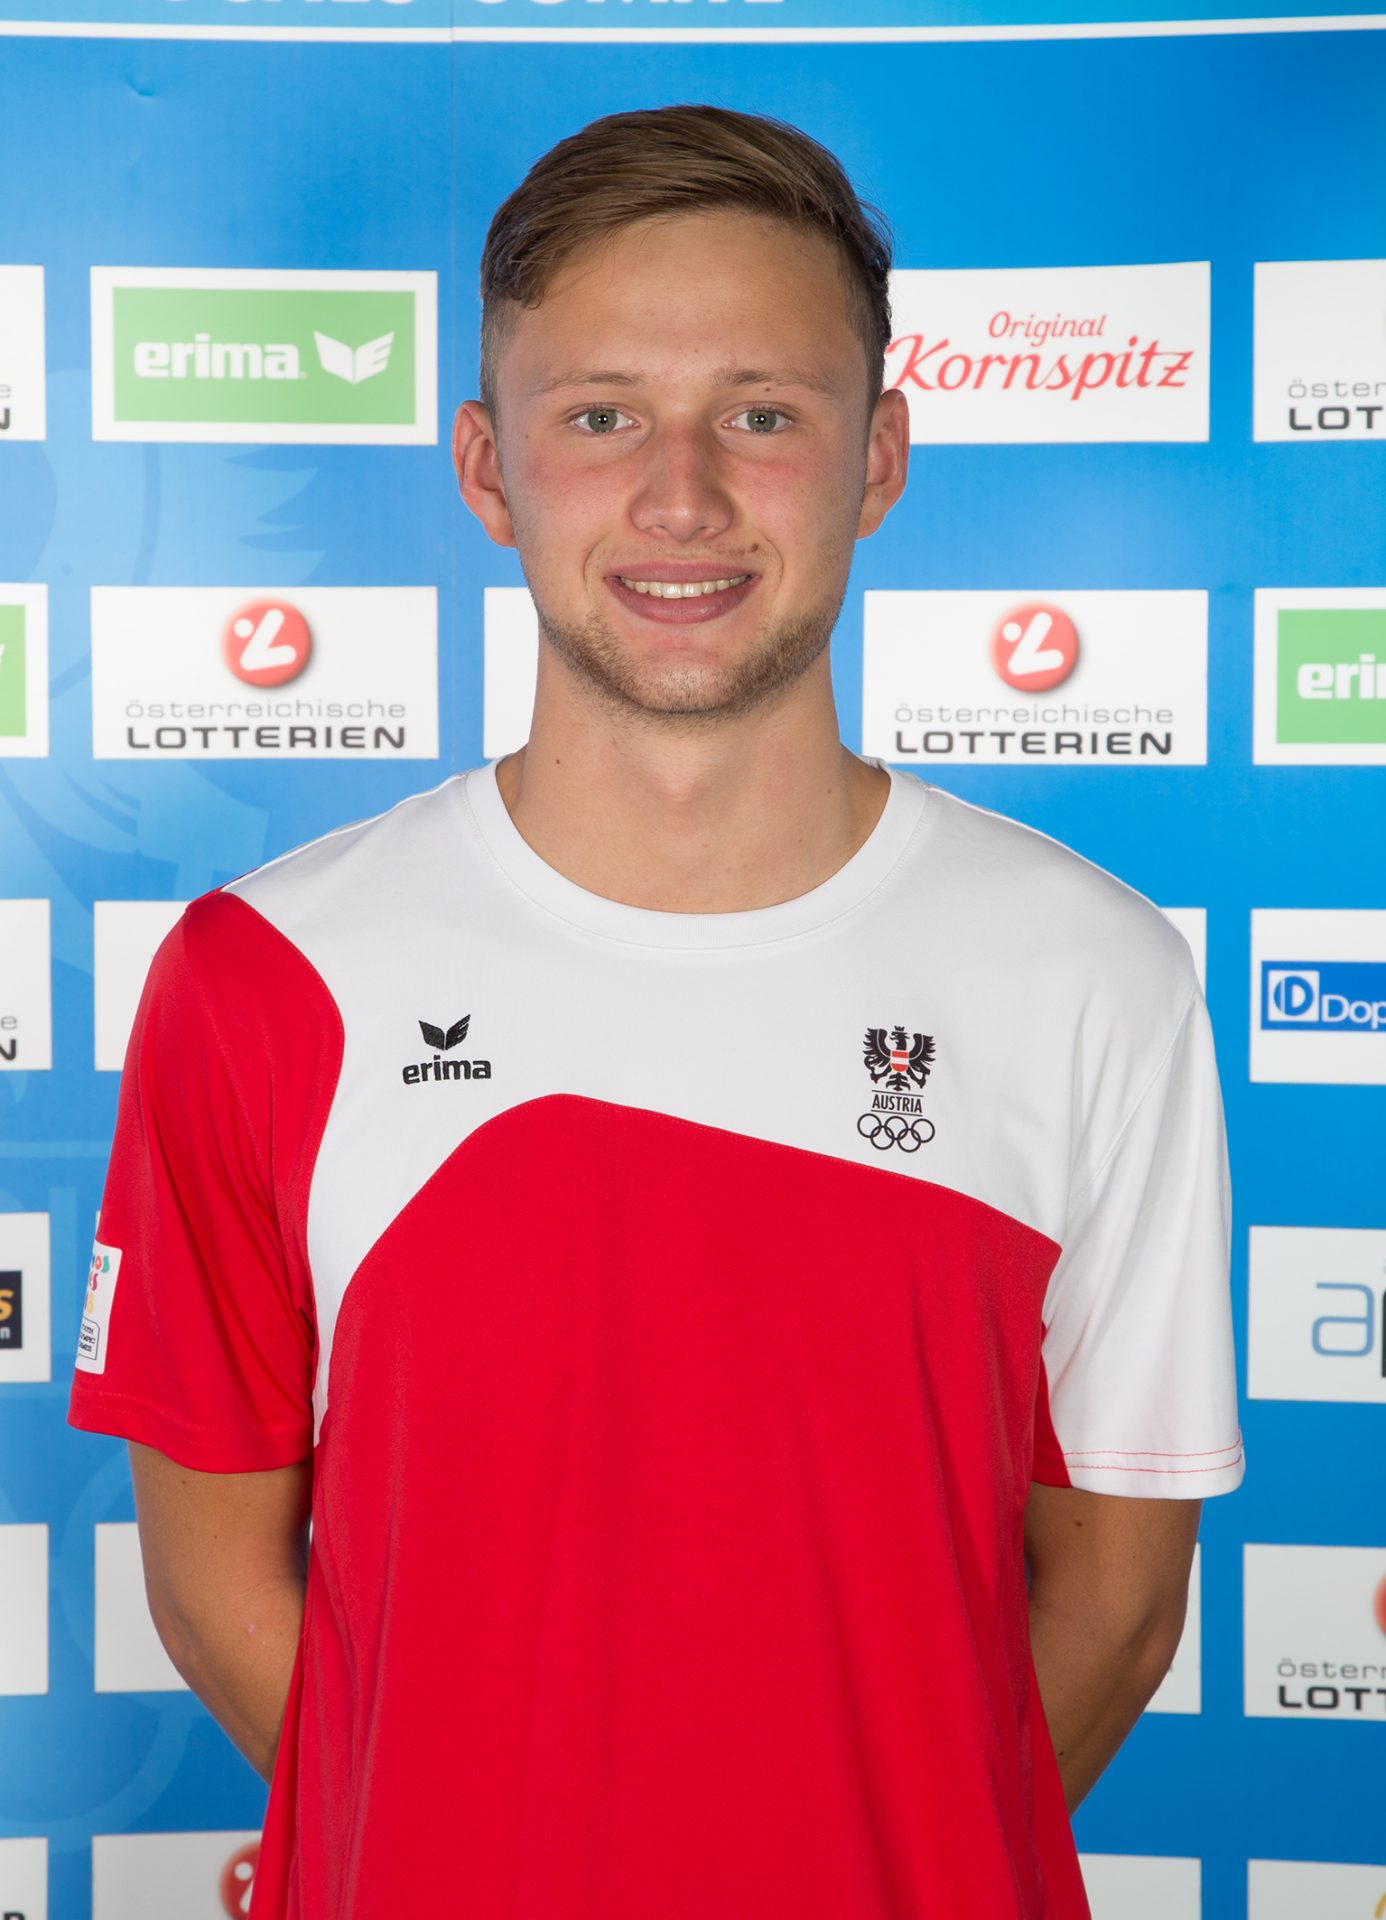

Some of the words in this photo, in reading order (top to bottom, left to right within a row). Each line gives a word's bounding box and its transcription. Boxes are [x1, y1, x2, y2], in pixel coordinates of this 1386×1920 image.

[988, 311, 1107, 348] Original
[134, 333, 300, 380] erima
[884, 334, 1195, 401] Kornspitz
[1297, 653, 1386, 700] eri
[125, 698, 407, 719] österreichische
[895, 703, 1174, 724] österreichische
[127, 726, 406, 750] LOTTERIEN
[895, 731, 1172, 756] LOTTERIEN
[402, 1054, 492, 1085] erima
[872, 1093, 923, 1114] AUSTRIA
